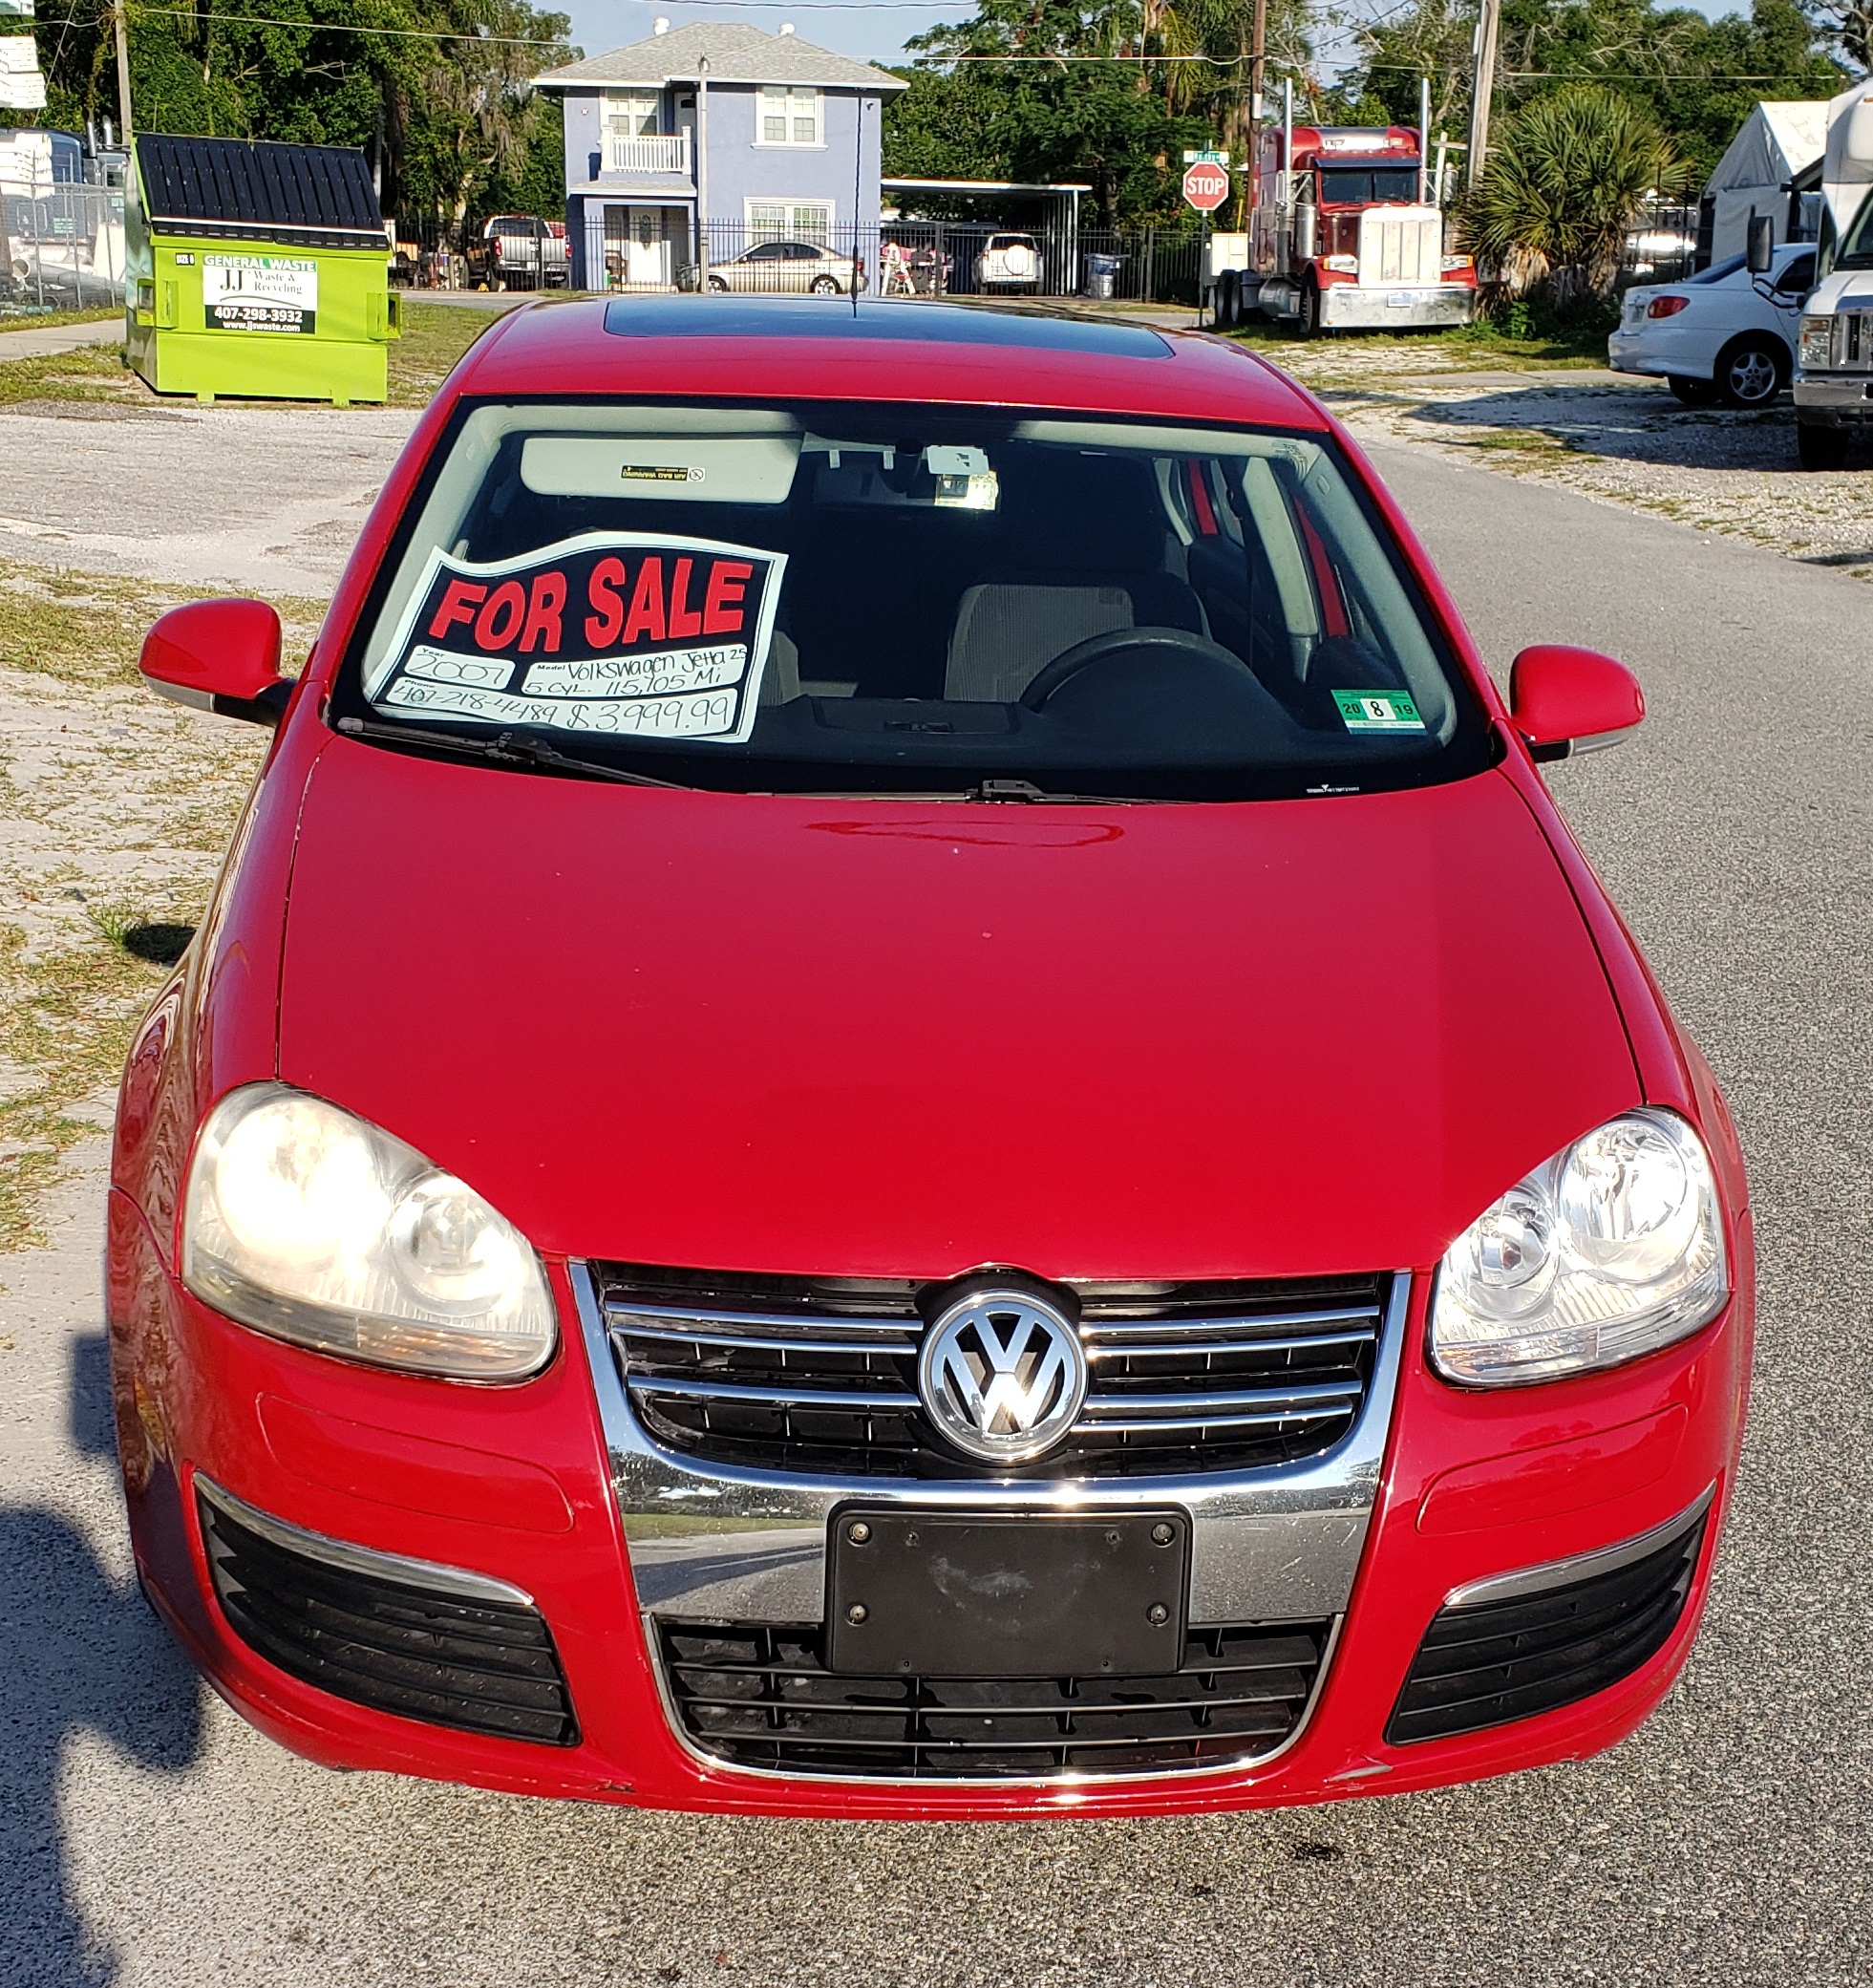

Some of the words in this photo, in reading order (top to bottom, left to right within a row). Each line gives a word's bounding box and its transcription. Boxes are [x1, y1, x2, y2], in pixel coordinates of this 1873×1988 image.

[1186, 177, 1224, 195] STOP
[204, 255, 266, 268] GENERAL
[270, 259, 315, 272] WASTE
[254, 270, 285, 282] Waste
[287, 273, 296, 282] &
[254, 282, 303, 294] Recycling
[214, 307, 303, 323] 407-298-3932
[429, 571, 568, 652] FOR
[585, 557, 754, 649] SALE
[422, 648, 445, 658] Year
[409, 653, 506, 685] 2007
[537, 663, 566, 672] Model
[680, 651, 727, 674] Jetta
[404, 678, 436, 689] Phone
[524, 682, 543, 693] 5
[692, 666, 722, 686] Mi
[394, 686, 558, 722] 407-218-4489
[1342, 702, 1362, 715] 20
[1370, 700, 1385, 717] 8
[1394, 704, 1415, 716] 19
